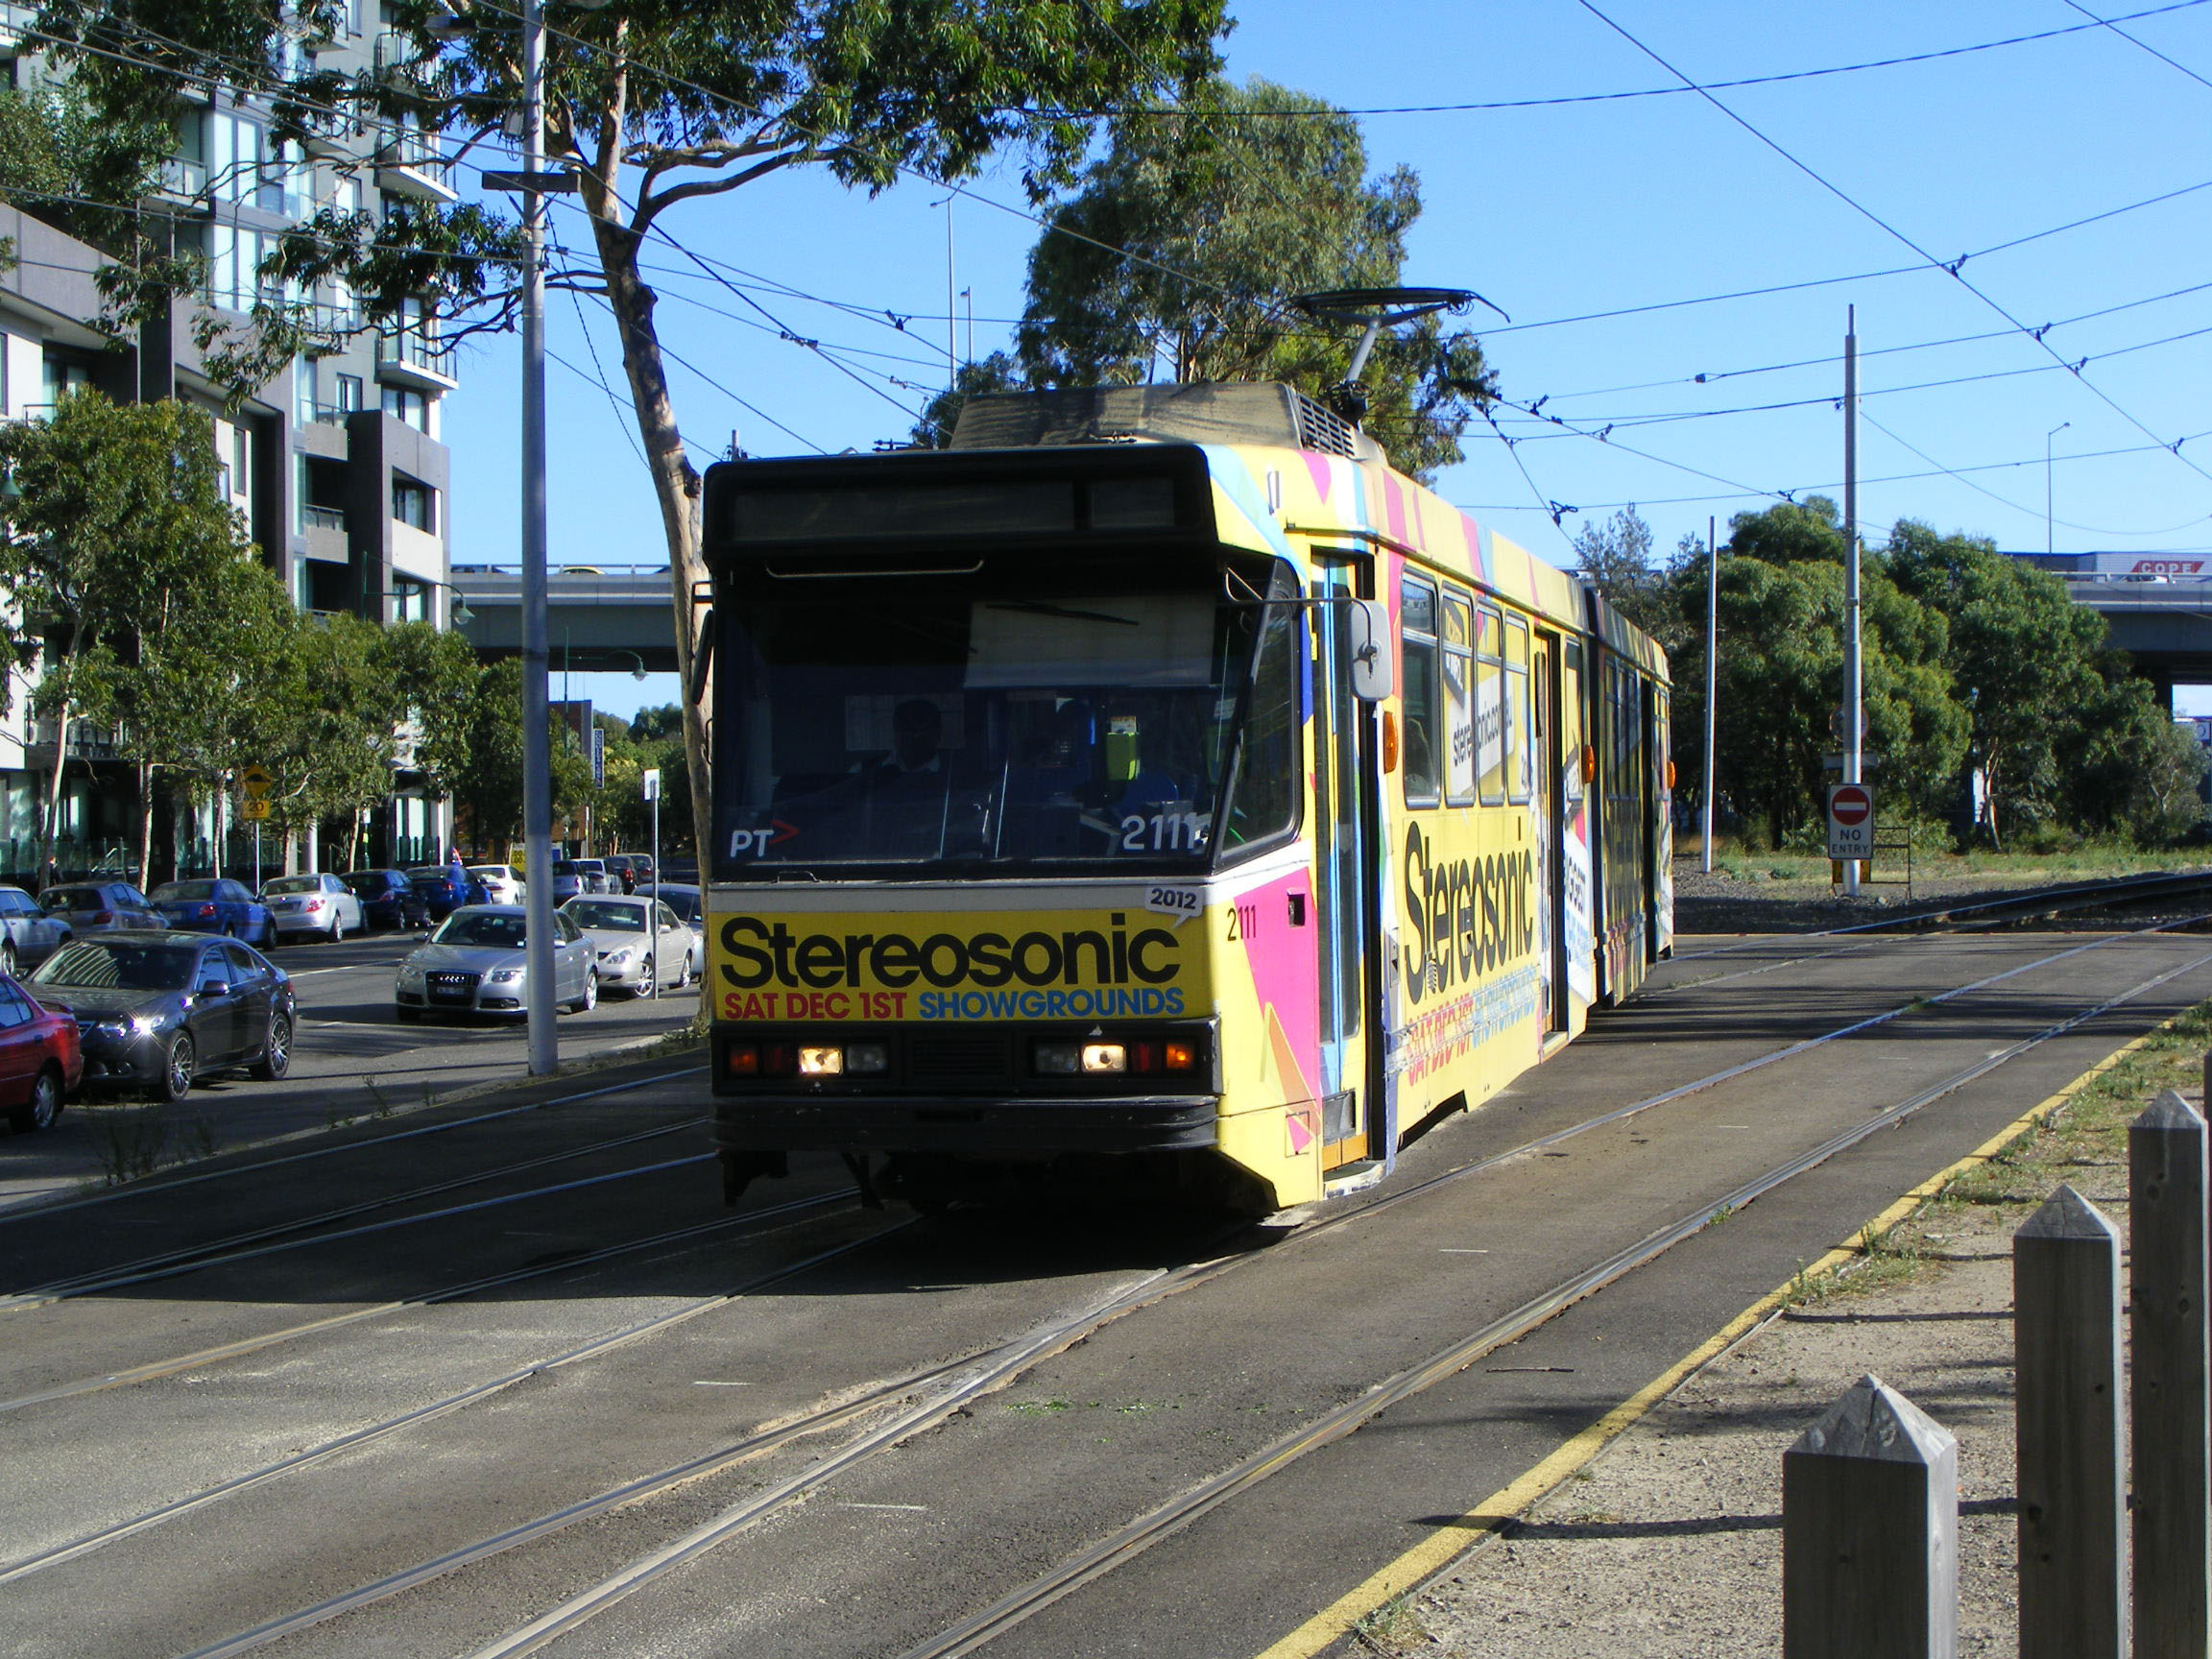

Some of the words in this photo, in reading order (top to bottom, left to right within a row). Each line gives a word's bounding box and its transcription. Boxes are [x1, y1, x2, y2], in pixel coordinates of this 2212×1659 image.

[2141, 563, 2194, 573] COPE
[249, 802, 264, 812] 20
[1121, 812, 1197, 851] 2111
[1839, 830, 1862, 841] NO
[1831, 844, 1868, 854] ENTRY
[1150, 888, 1197, 910] 2012
[1404, 816, 1533, 1005] Stereosonic
[1227, 905, 1257, 942] 2111
[720, 913, 1180, 988] Stereosonic
[725, 992, 781, 1020] SAT
[786, 991, 851, 1020] DEC
[859, 990, 907, 1019] 1ST
[919, 987, 1186, 1019] SHOWGROUNDS
